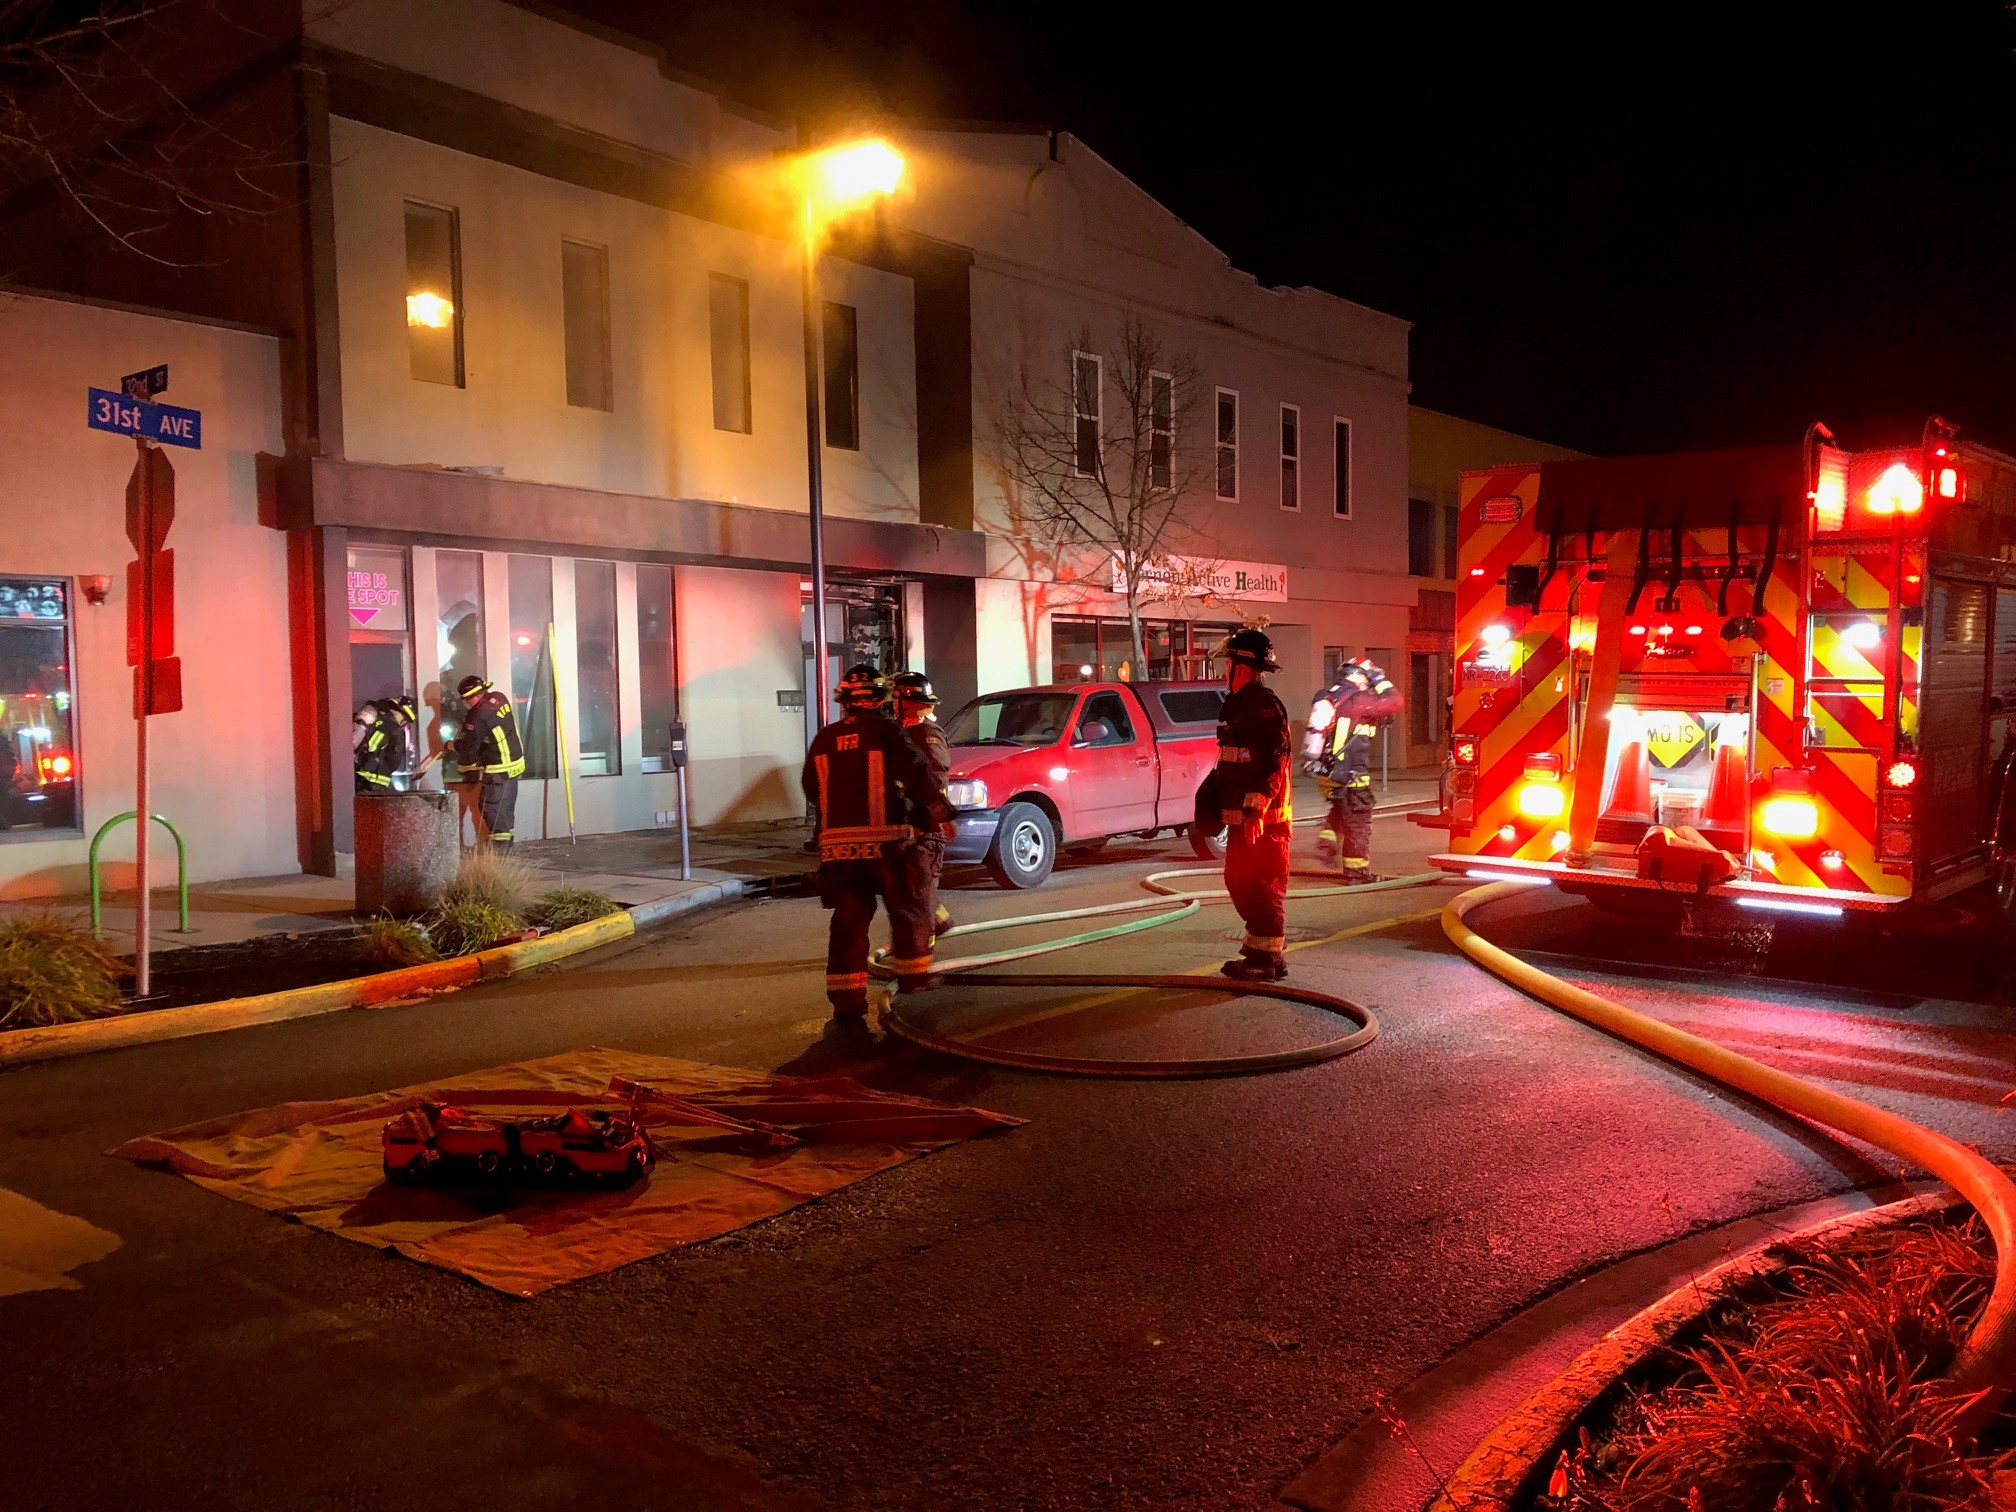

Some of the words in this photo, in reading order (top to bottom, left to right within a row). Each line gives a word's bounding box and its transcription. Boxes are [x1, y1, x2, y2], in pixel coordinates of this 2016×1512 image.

[96, 398, 141, 430] 31st
[160, 415, 193, 438] AVE
[347, 572, 371, 588] HIS
[373, 573, 387, 588] IS
[1235, 571, 1277, 591] Health
[358, 589, 399, 605] SPOT
